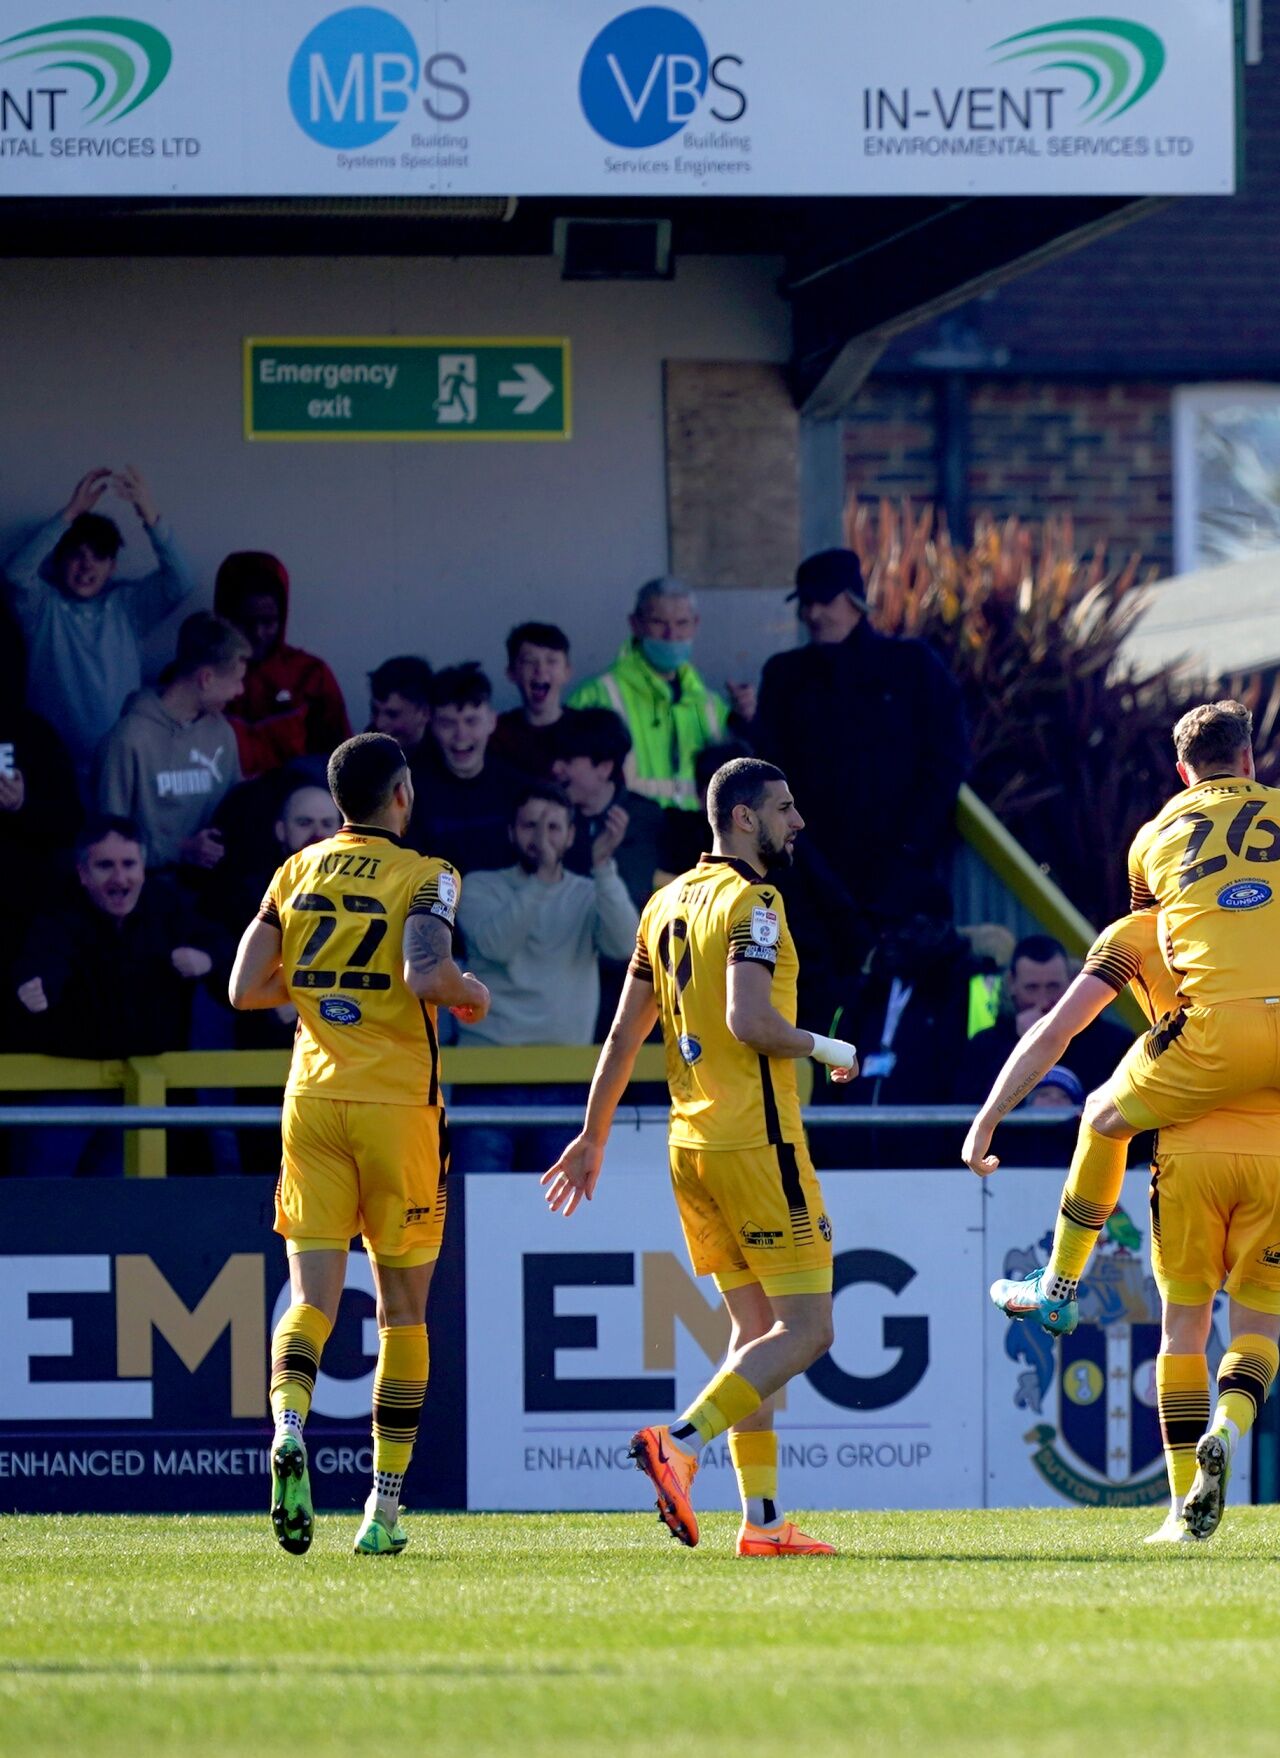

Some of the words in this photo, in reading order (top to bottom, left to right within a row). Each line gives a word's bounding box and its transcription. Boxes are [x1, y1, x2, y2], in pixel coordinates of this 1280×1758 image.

[310, 52, 470, 122] MBS
[606, 54, 747, 122] VBS
[863, 87, 1064, 131] IN-VENT
[50, 138, 154, 157] SERVICES
[162, 138, 200, 157] LTD
[411, 133, 468, 150] Building
[683, 132, 751, 151] Building
[863, 136, 1041, 157] ENVIRONMENTAL
[1049, 136, 1149, 157] SERVICES
[1154, 136, 1194, 157] LTD
[336, 152, 396, 171] Systems
[401, 152, 468, 171] Specialist
[604, 156, 668, 174] Services
[674, 156, 751, 177] Engineers
[259, 358, 398, 389] Emergency
[307, 396, 352, 418] exit
[157, 769, 211, 797] PUMA
[317, 852, 382, 880] KIZZI
[292, 893, 390, 990] 22
[836, 1442, 932, 1470] GROUP
